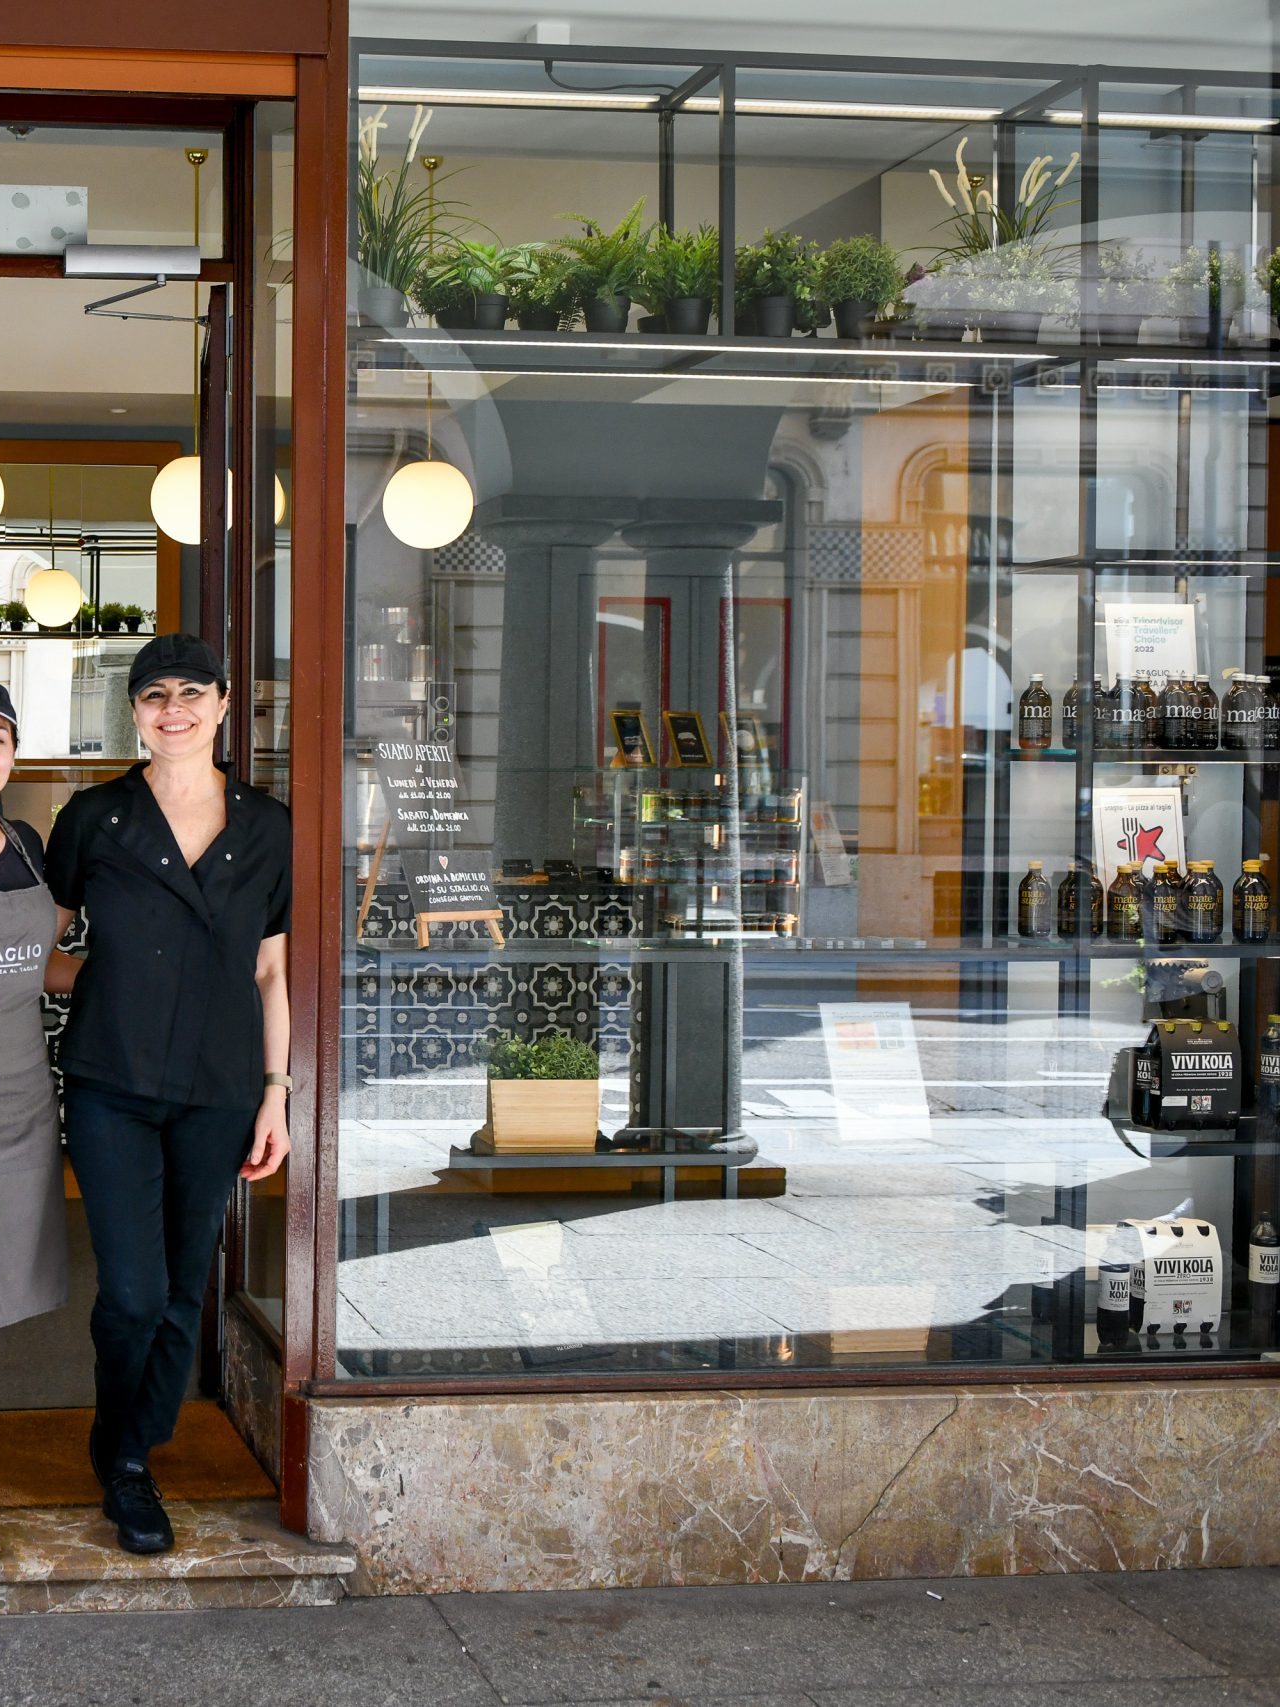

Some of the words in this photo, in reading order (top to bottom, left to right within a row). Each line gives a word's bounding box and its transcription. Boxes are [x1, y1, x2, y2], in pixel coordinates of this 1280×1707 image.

[1134, 635, 1166, 643] Choice
[378, 743, 413, 760] SIAMO
[415, 744, 452, 762] APERTI
[415, 874, 443, 884] ORDINA
[443, 873, 451, 882] A
[450, 872, 486, 882] DOMICILIO
[1114, 896, 1138, 904] mate
[1153, 895, 1176, 903] mate
[1188, 895, 1213, 903] mate
[1244, 895, 1268, 903] mate
[1171, 1056, 1200, 1069] VIVI
[1201, 1055, 1233, 1069] KOLA
[1260, 1255, 1279, 1264] VIVI
[1153, 1260, 1181, 1274] VIVI
[1183, 1259, 1214, 1273] KOLA
[1259, 1264, 1279, 1272] KOLA
